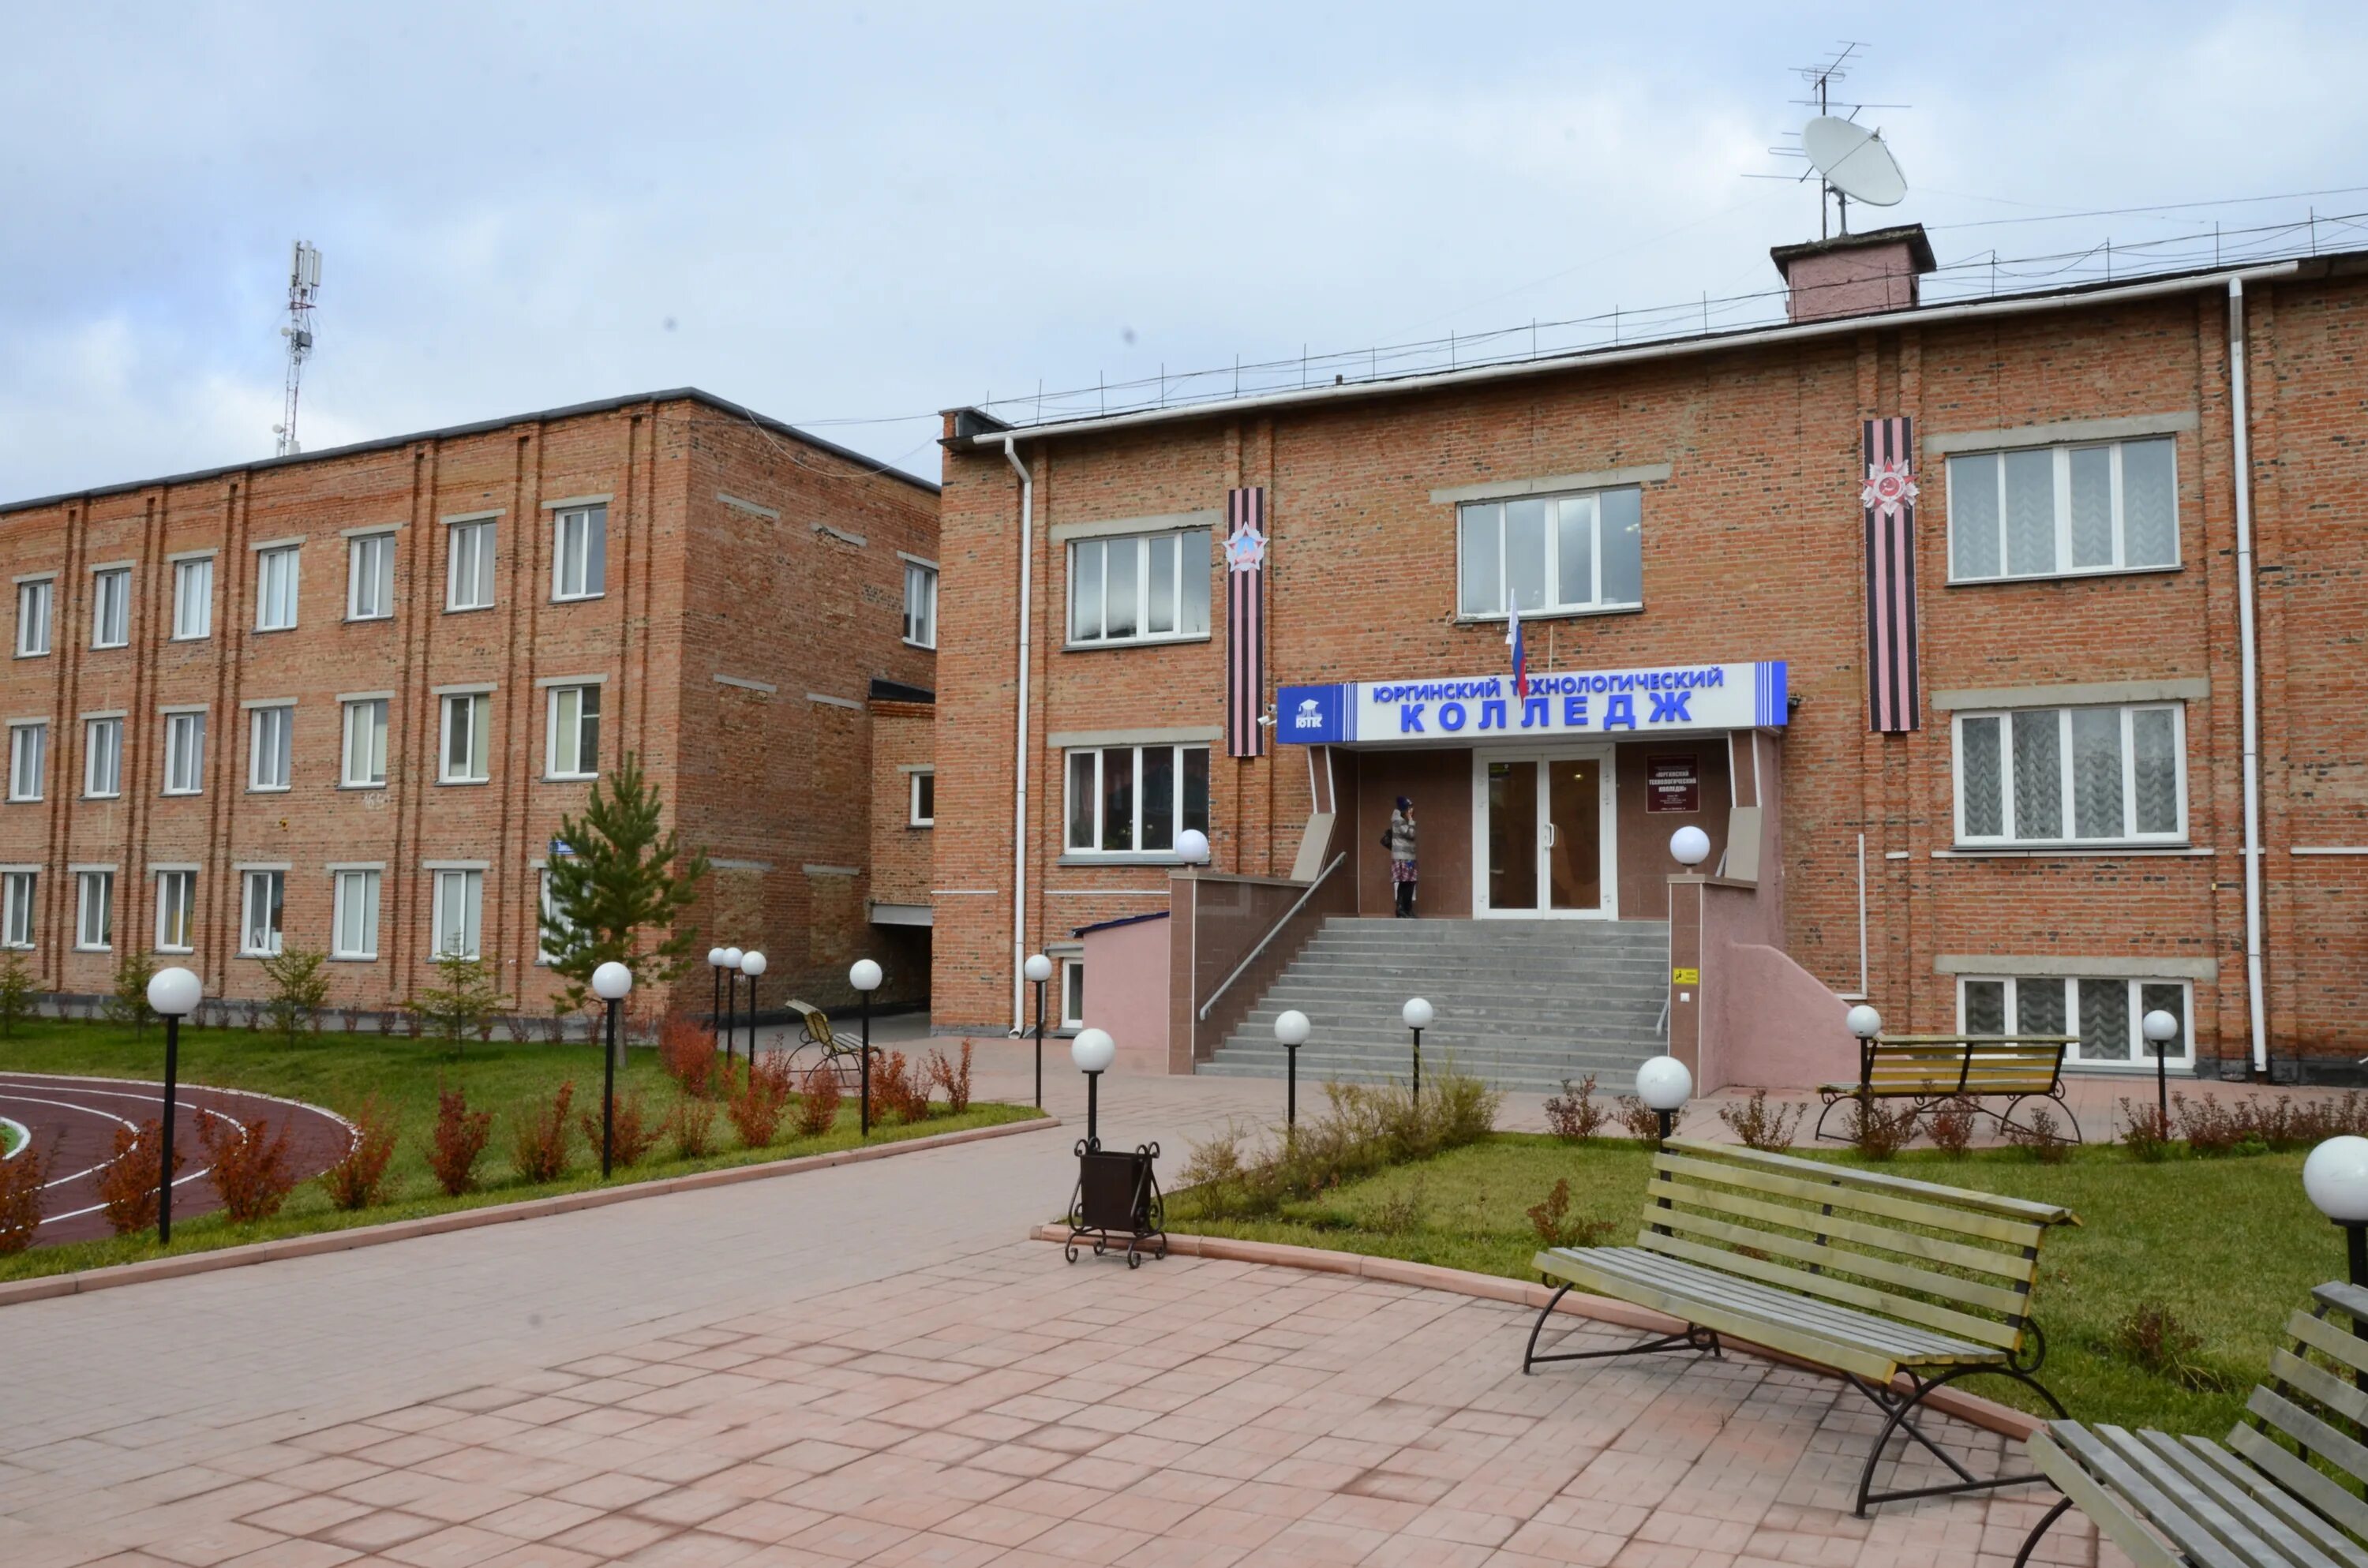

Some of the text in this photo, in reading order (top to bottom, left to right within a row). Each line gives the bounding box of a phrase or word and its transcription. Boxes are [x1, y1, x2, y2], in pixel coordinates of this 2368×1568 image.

[1373, 667, 1725, 704] ЮРГИНСКИЙ ТХНОЛОГИЧЕСКИЙ
[1295, 714, 1323, 728] ЮТК
[1400, 690, 1693, 732] КОЛЛЕДЖ
